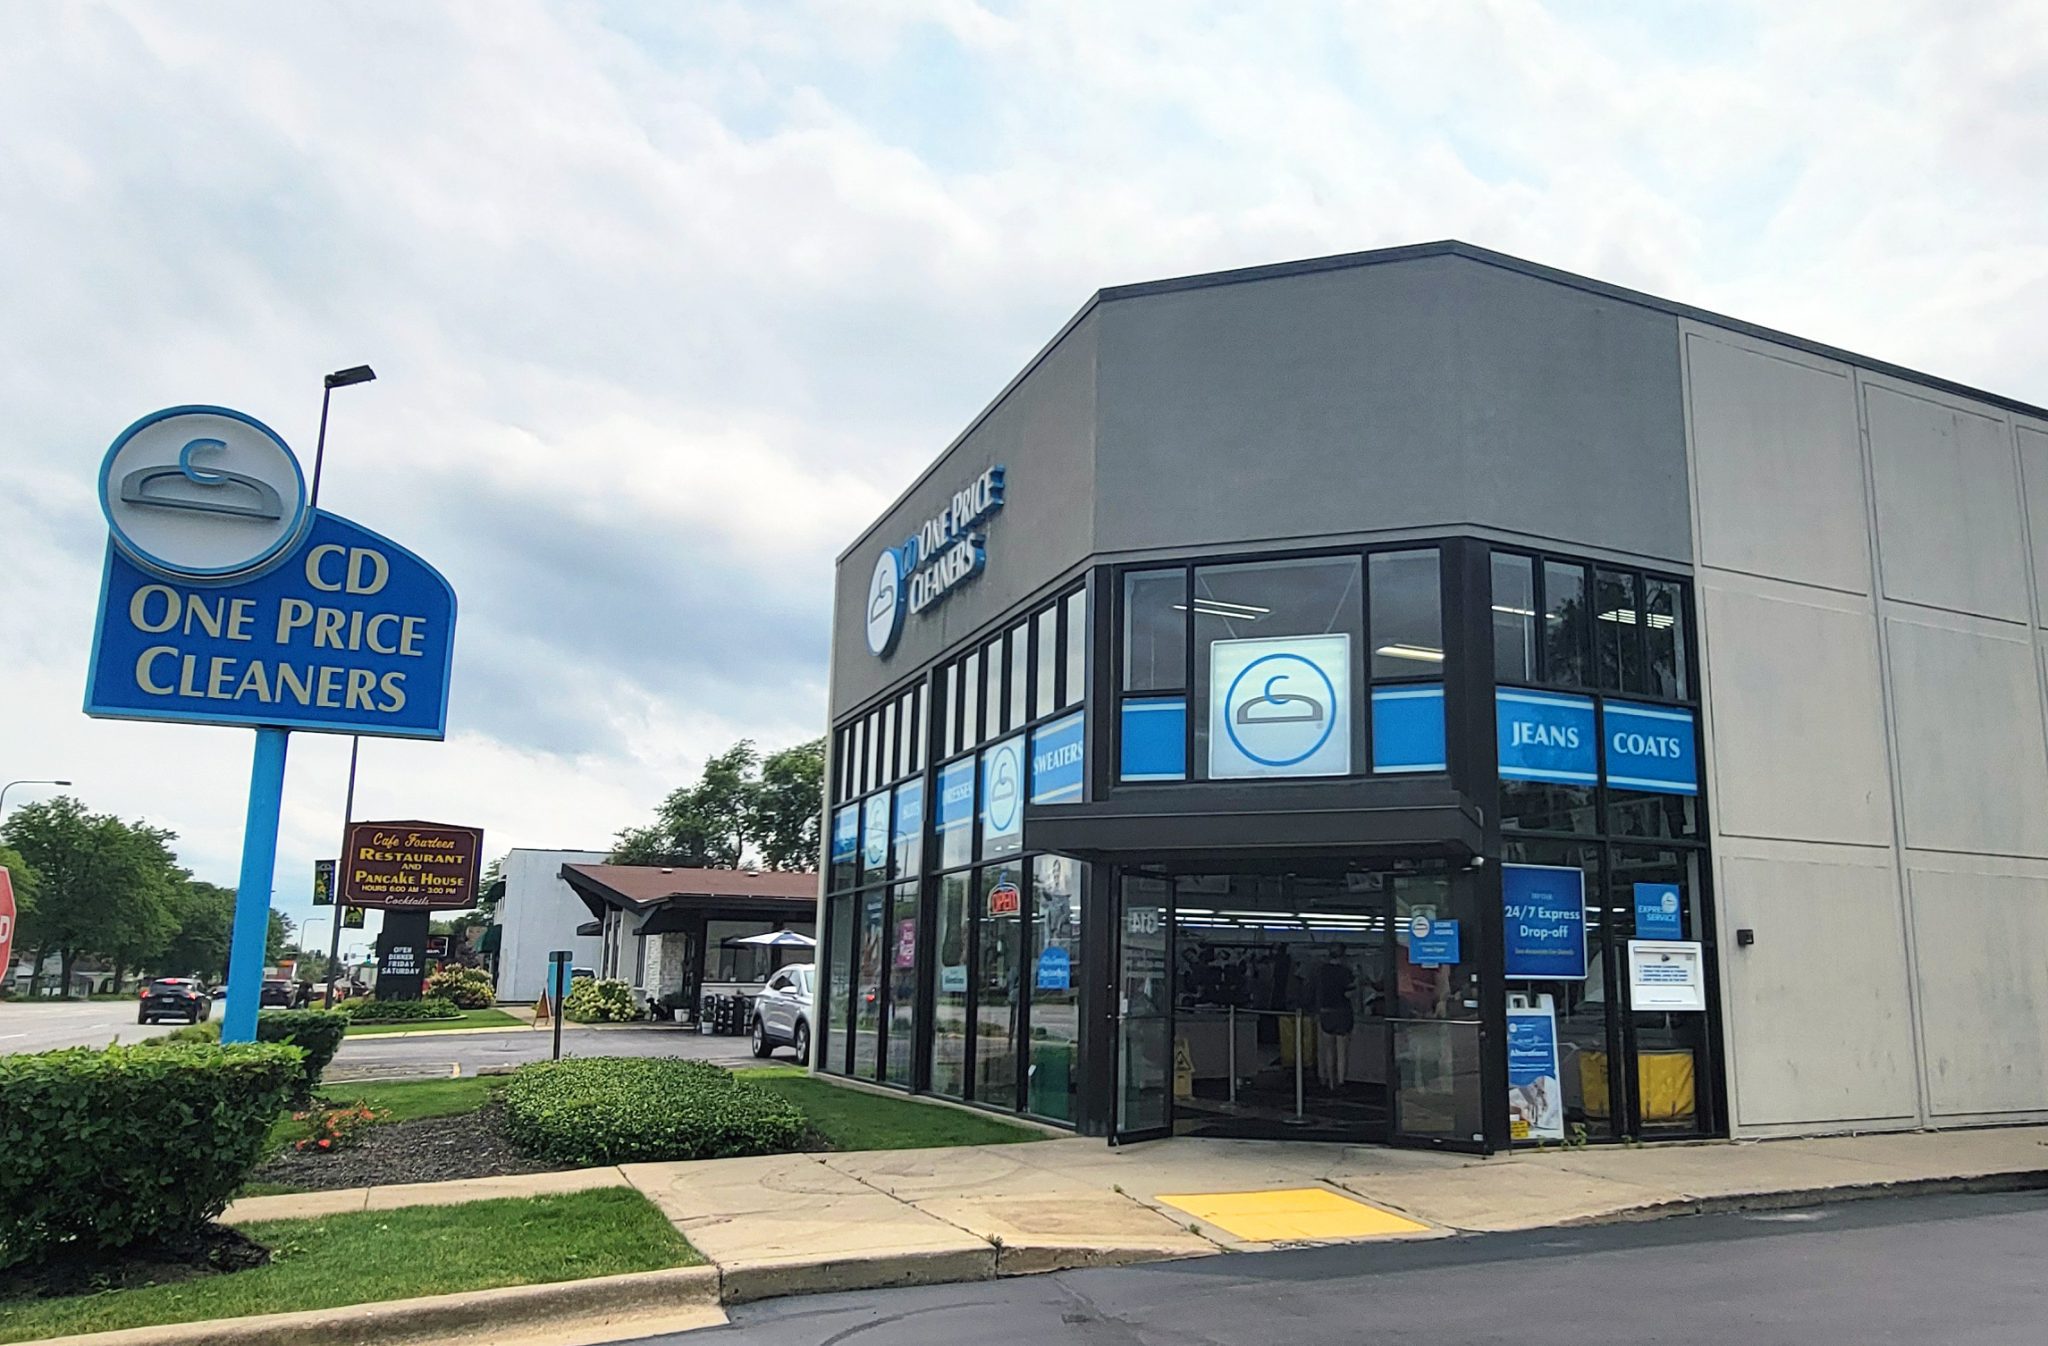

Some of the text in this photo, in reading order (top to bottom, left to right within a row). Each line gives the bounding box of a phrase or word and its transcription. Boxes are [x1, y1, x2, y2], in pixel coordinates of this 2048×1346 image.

[919, 508, 952, 560] ONE
[951, 465, 1004, 536] PRICE
[305, 544, 390, 595] CD
[910, 533, 983, 614] CLEANERS
[129, 584, 427, 657] ONE PRICE
[135, 646, 407, 713] CLEANERS
[1511, 721, 1580, 748] JEANS
[1613, 732, 1681, 758] COATS
[1033, 741, 1083, 775] SWEATERS
[373, 832, 456, 849] Cafe Fourteen
[359, 847, 465, 864] RESTAURANT
[421, 873, 464, 886] HOUSE
[385, 895, 430, 905] Cocktails
[1504, 905, 1581, 922] 24/7 Express
[1647, 914, 1676, 922] SERVICE
[1520, 925, 1568, 941] Drop-off
[381, 967, 420, 975] SATURDAY
